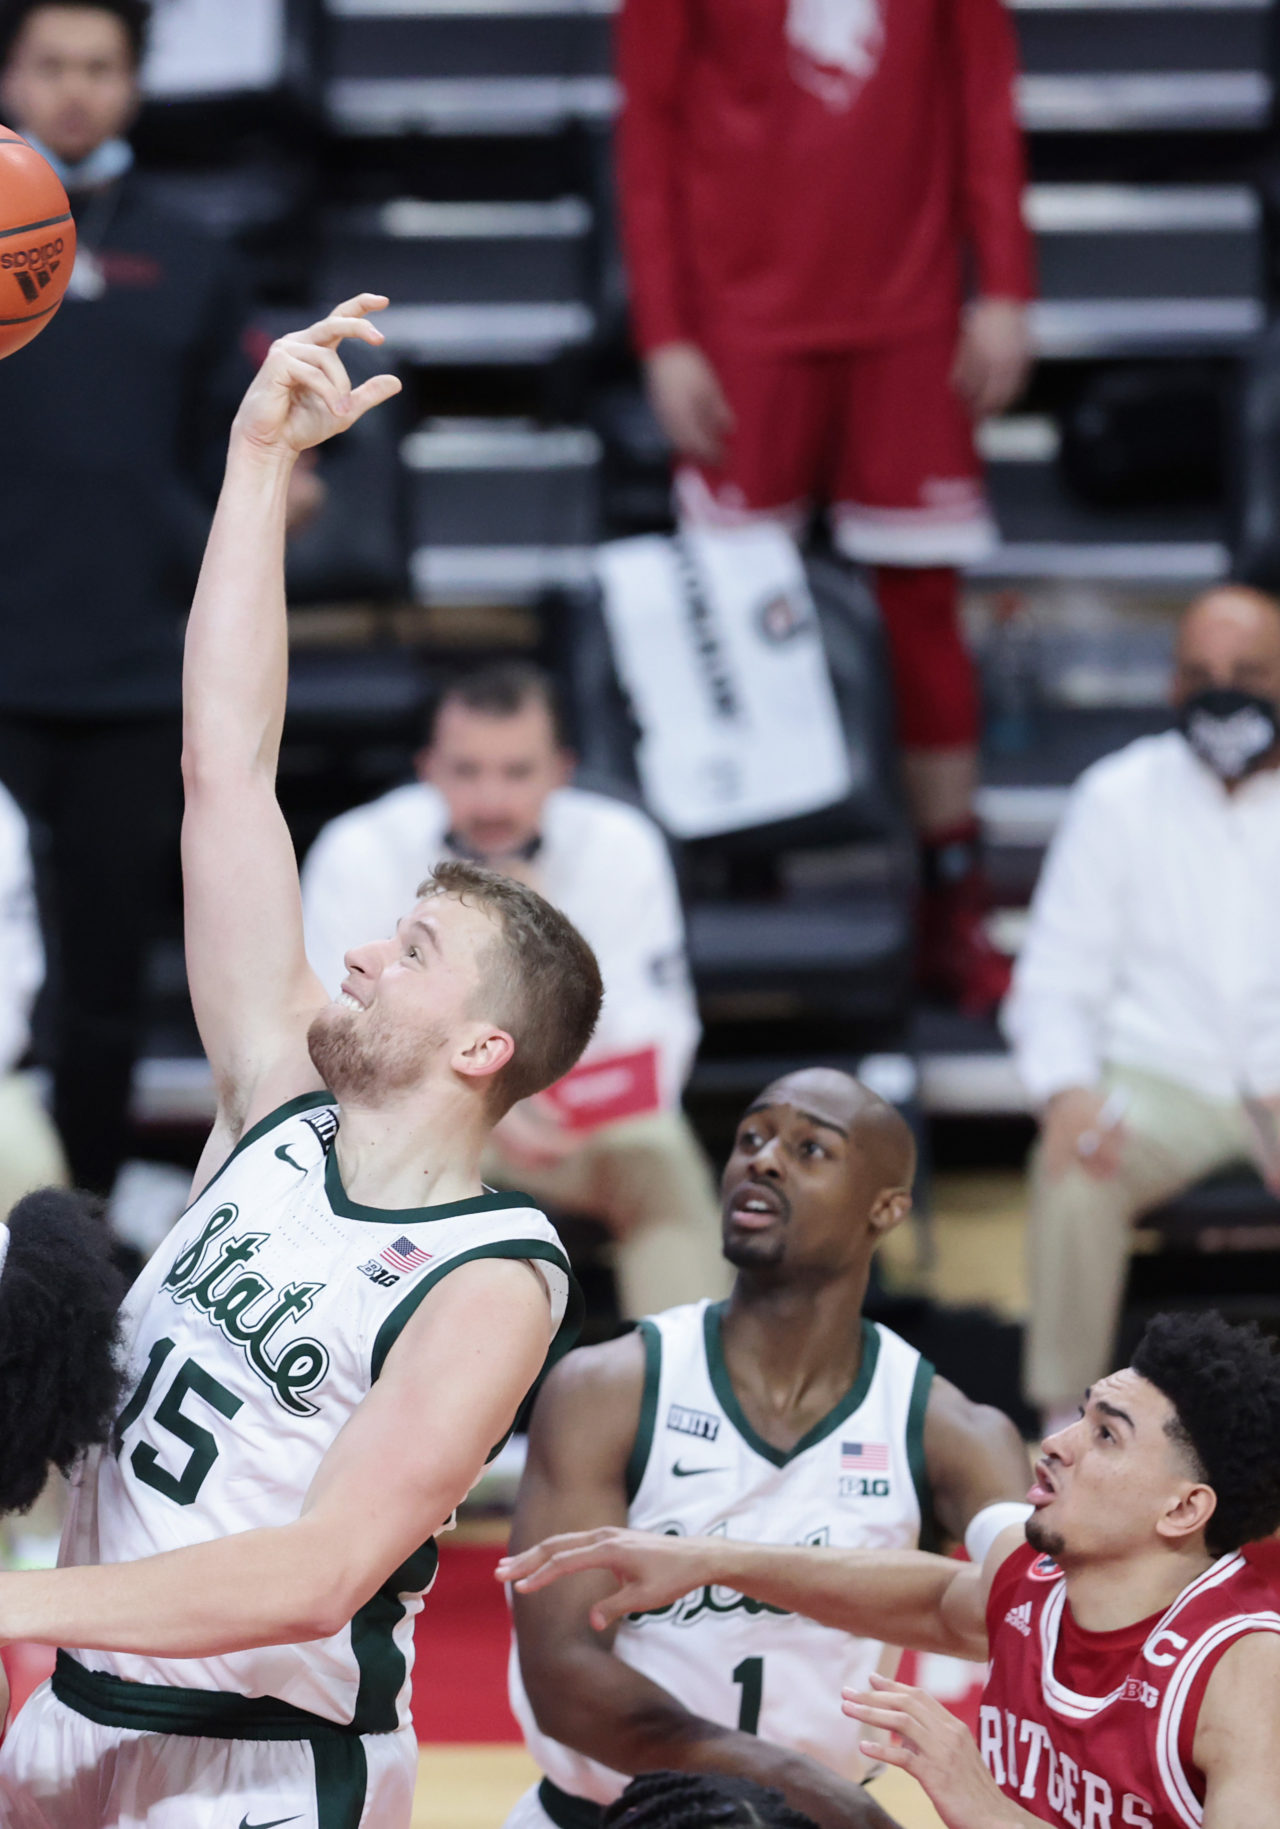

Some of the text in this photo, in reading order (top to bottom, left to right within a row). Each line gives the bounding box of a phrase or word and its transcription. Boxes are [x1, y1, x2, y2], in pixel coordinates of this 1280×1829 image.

[1, 237, 64, 272] adidas
[159, 1203, 329, 1417] State
[115, 1337, 244, 1506] 15
[1143, 1629, 1188, 1667] C
[732, 1656, 763, 1736] 1
